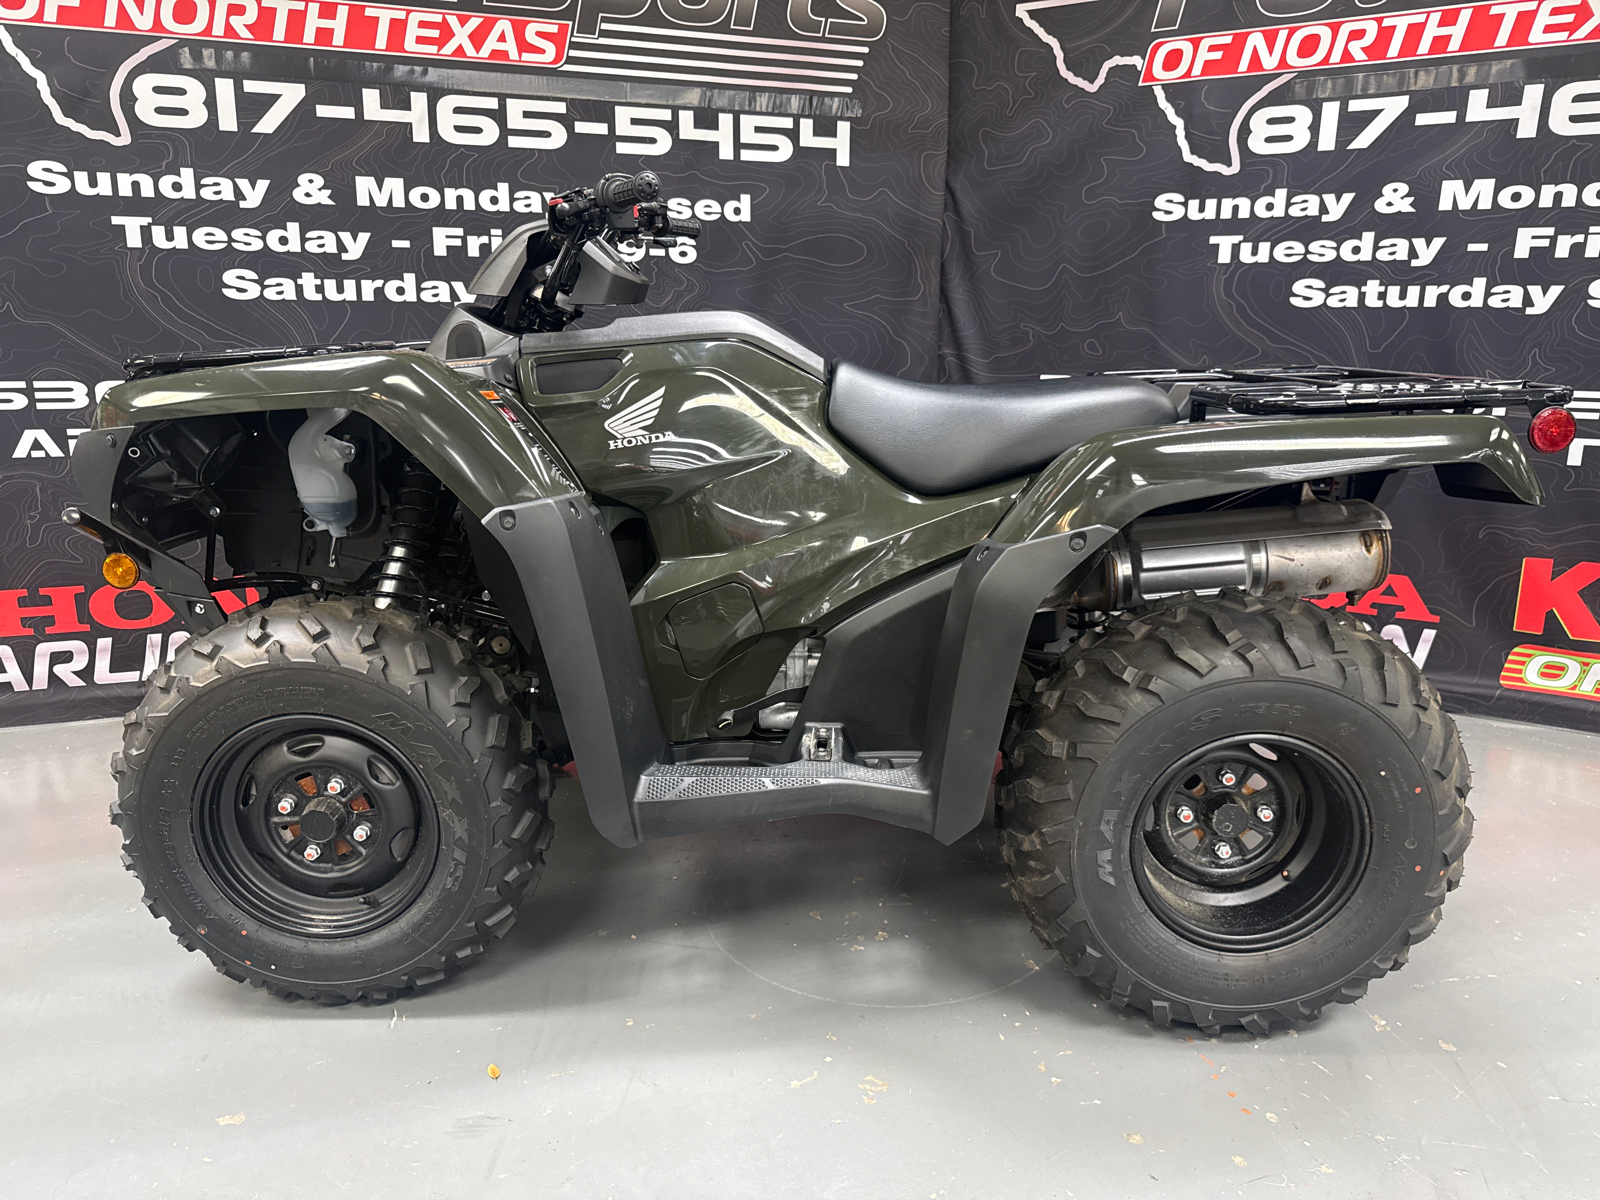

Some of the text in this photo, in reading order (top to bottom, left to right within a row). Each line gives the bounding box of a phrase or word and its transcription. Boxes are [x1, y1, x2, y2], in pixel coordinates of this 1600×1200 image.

[104, 0, 349, 47] NORTH
[364, 8, 558, 63] TEXAS
[1151, 34, 1234, 80] OF
[1237, 8, 1474, 72] NORTH
[132, 73, 850, 167] 817-465-5454
[27, 160, 270, 208] Sunday
[292, 173, 335, 205] &
[1152, 188, 1355, 222] Sunday
[1374, 182, 1416, 213] &
[111, 216, 371, 260] Tuesday
[1209, 232, 1447, 266] Tuesday
[221, 269, 478, 304] Saturday
[1289, 277, 1565, 314] Saturday
[608, 431, 677, 450] HONDA
